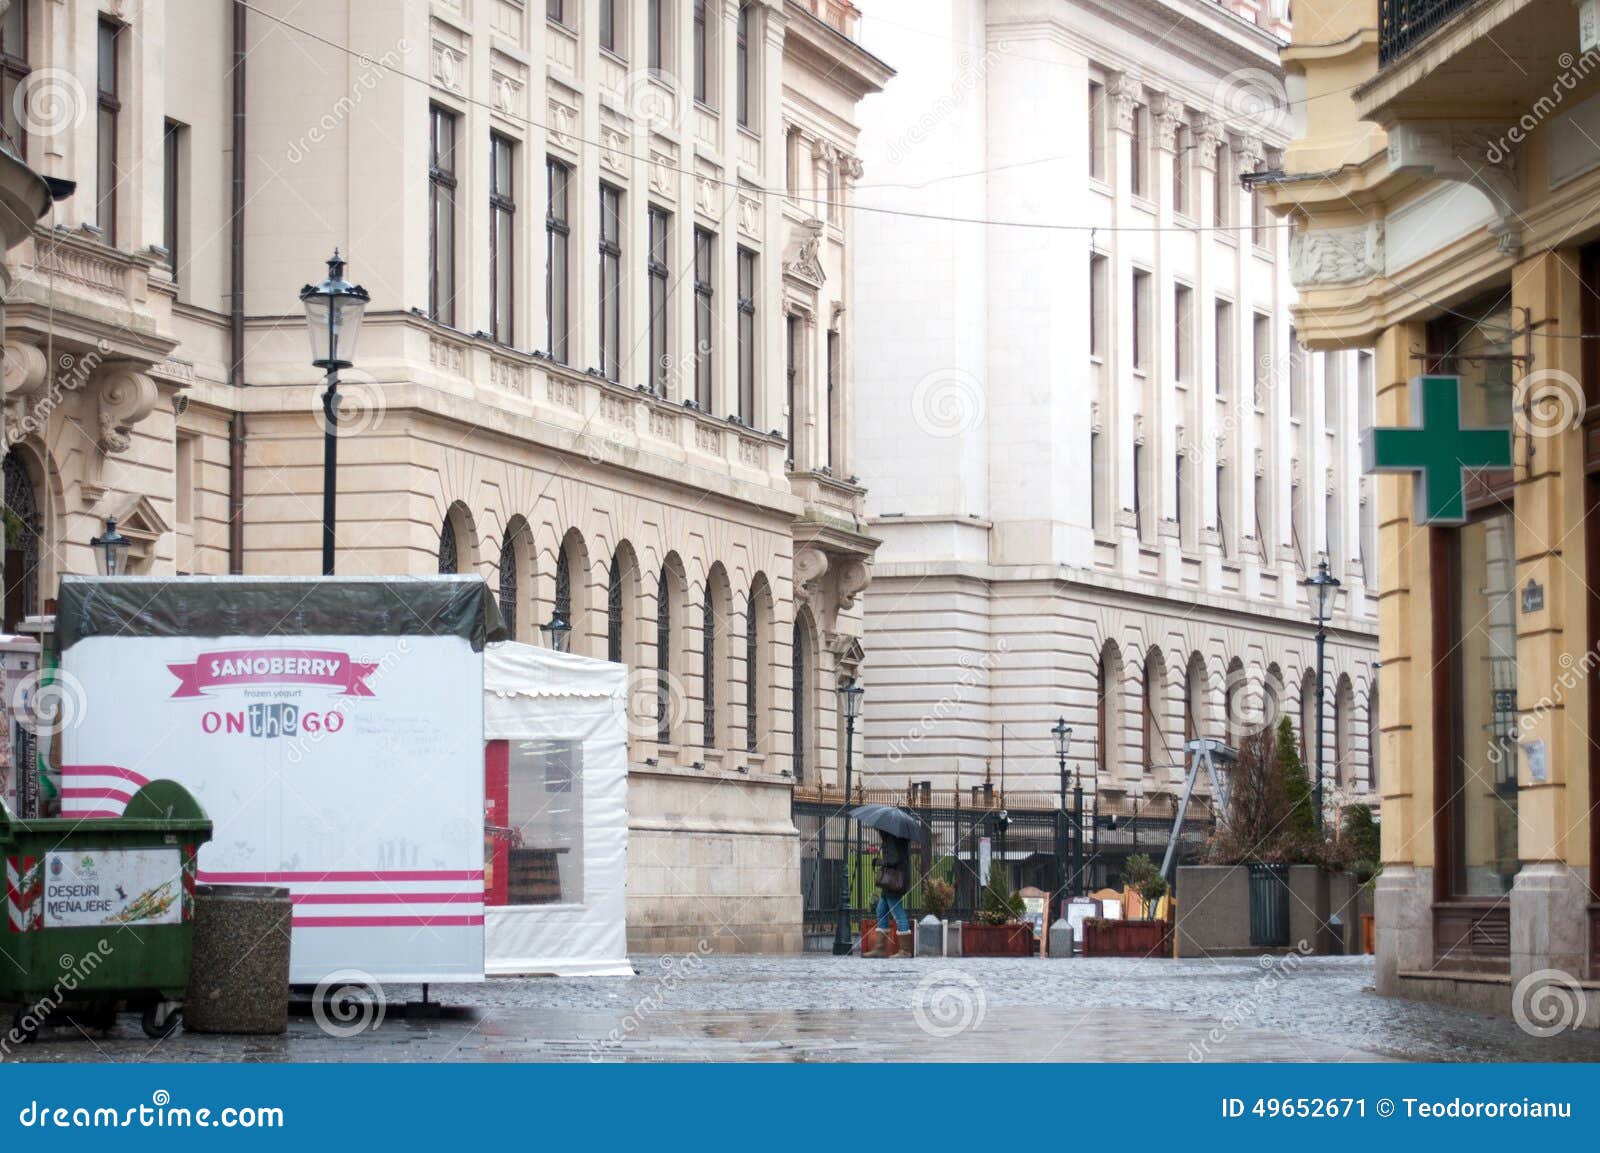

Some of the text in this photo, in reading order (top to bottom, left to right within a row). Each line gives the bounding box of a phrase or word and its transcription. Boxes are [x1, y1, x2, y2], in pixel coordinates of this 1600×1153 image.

[210, 658, 341, 677] SANOBERRY
[244, 688, 302, 699] frozen yogurt
[202, 704, 344, 737] ON the GO
[48, 900, 112, 913] MENAJERE
